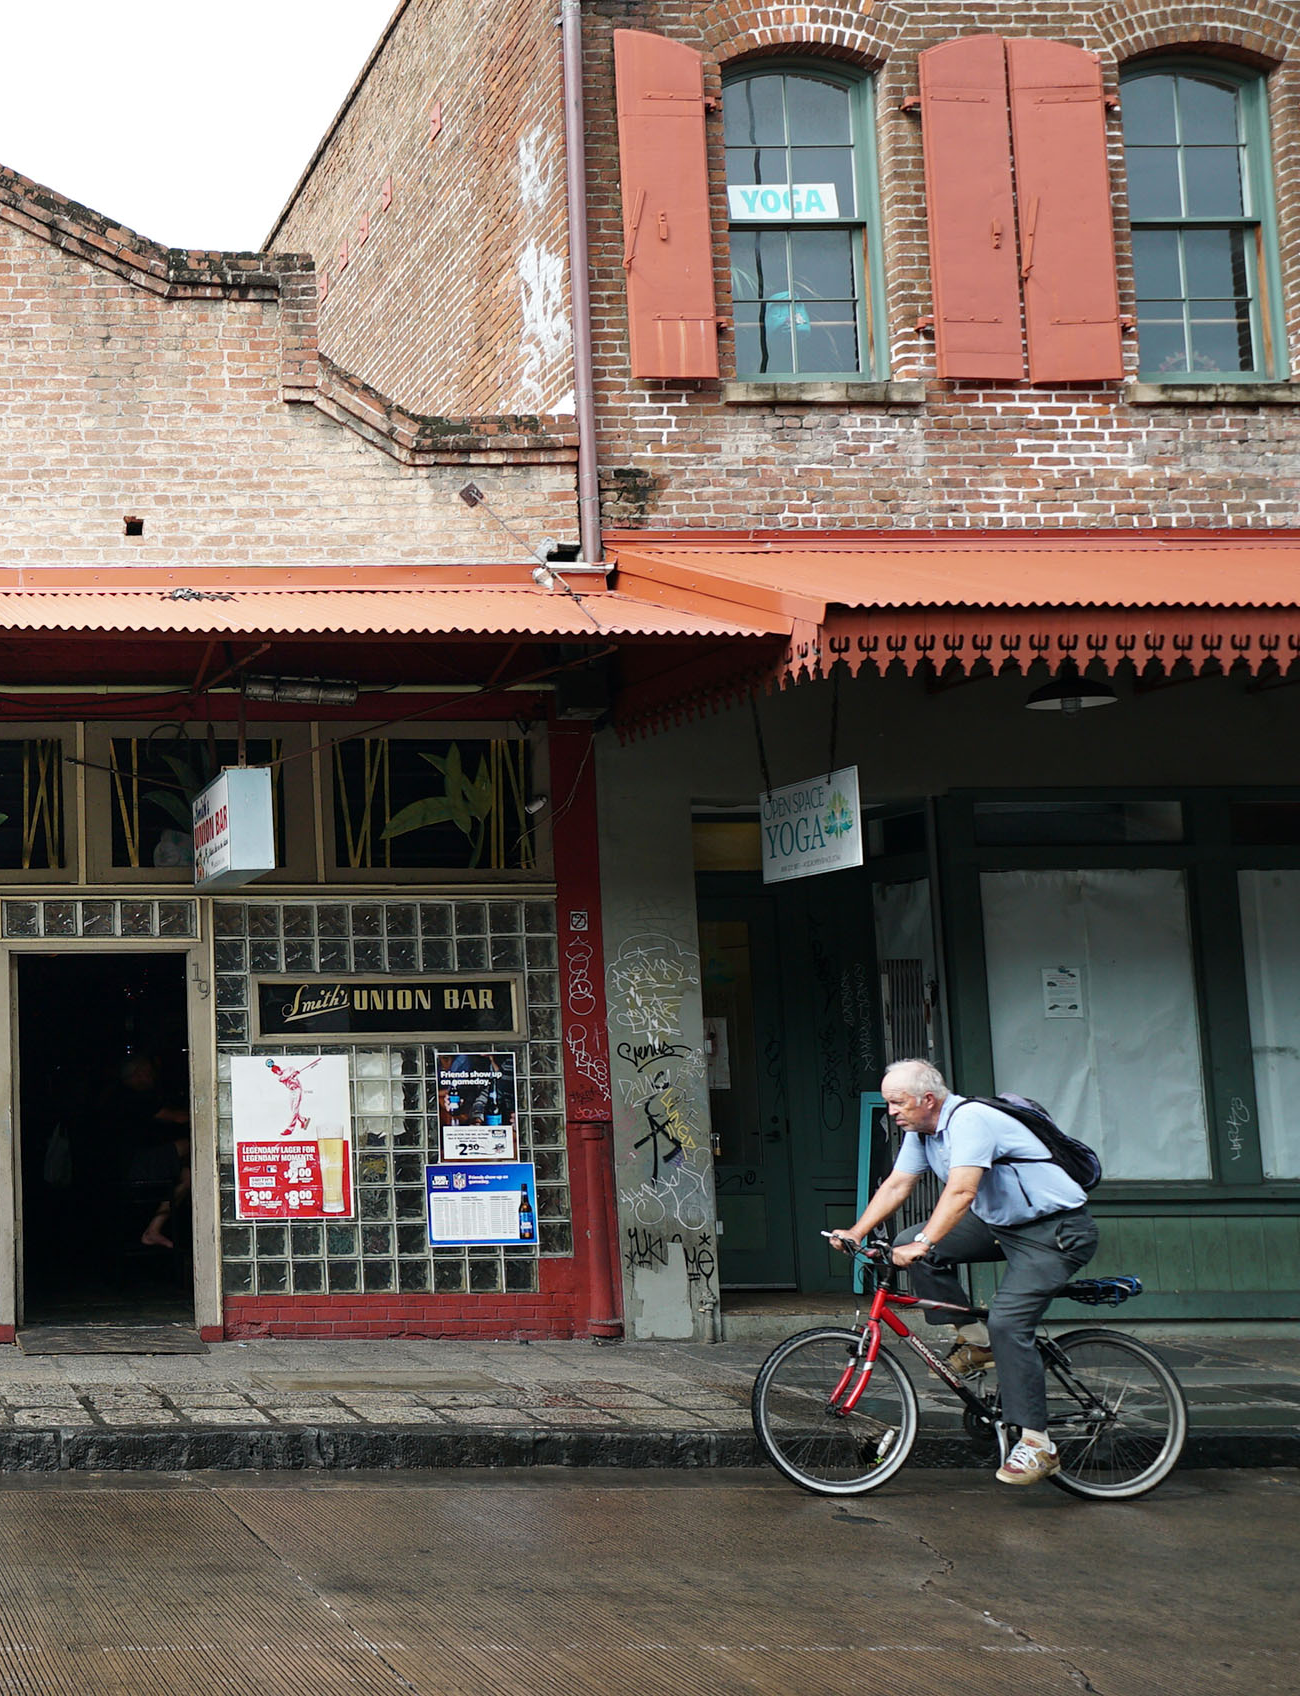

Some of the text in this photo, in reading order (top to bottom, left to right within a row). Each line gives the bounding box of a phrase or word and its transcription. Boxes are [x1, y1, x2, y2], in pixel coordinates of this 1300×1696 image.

[740, 189, 826, 213] YOGA
[763, 786, 825, 820] OPEN SPACE
[194, 815, 214, 851] UNION
[215, 805, 228, 836] BAR
[765, 813, 826, 859] YOGA
[192, 963, 211, 1000] 19
[282, 984, 495, 1023] Smith's UNION BAR
[452, 1079, 491, 1087] gameday.
[492, 1071, 502, 1079] up
[242, 1146, 280, 1154] LEGENDARY
[242, 1154, 316, 1162] LEGENDARY MOMENTS.
[911, 1335, 959, 1386] MONGOOSE
